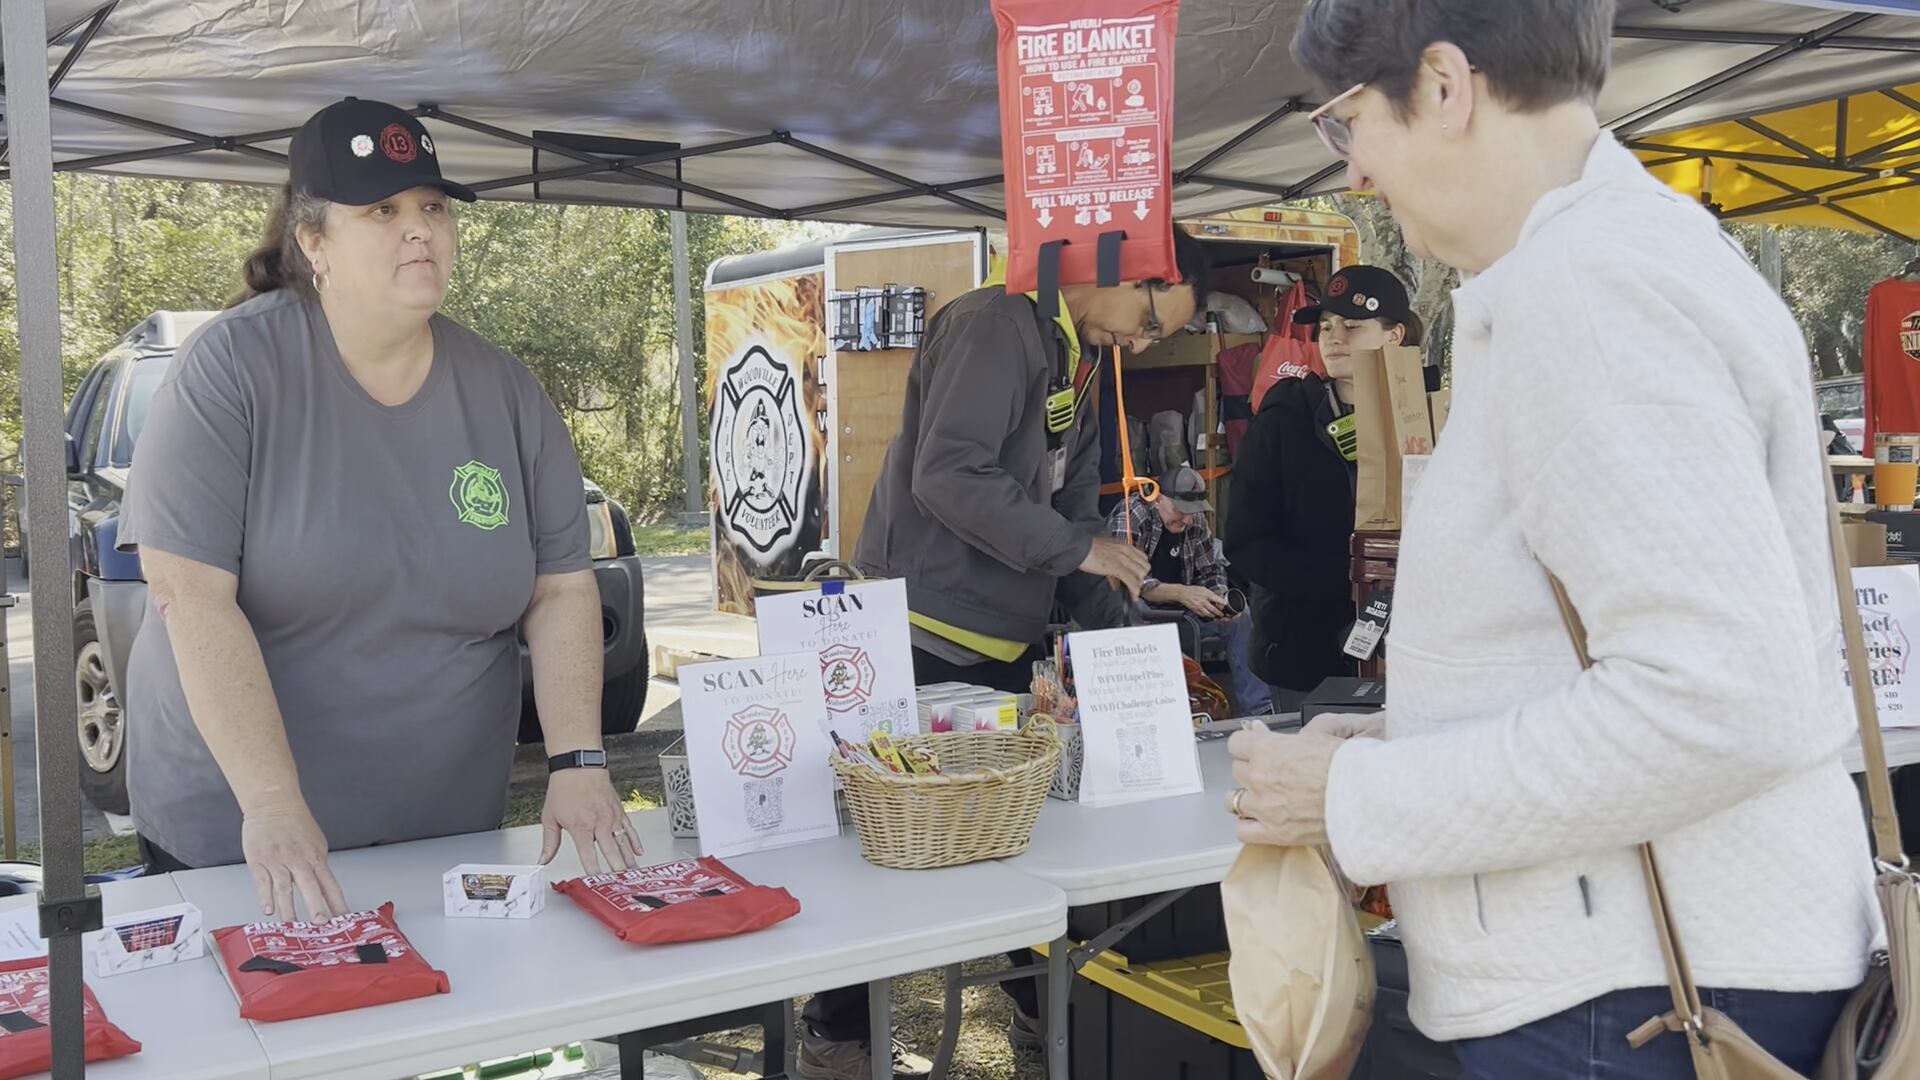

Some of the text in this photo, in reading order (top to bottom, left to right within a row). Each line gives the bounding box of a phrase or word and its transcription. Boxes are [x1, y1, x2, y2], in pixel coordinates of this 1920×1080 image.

[1017, 33, 1058, 59] FIRE
[1063, 24, 1155, 55] BLANKET
[1026, 64, 1046, 73] HOW
[1048, 62, 1059, 71] TO
[1061, 60, 1078, 70] USE
[1079, 59, 1086, 68] A
[1088, 57, 1107, 67] FIRE
[1109, 54, 1148, 66] BLANKET
[391, 136, 408, 151] 13
[1032, 196, 1057, 209] PULL
[1059, 193, 1091, 206] TAPES
[1093, 191, 1107, 204] TO
[1109, 187, 1155, 202] RELEASE
[802, 592, 863, 618] SCAN
[1855, 588, 1889, 606] ffle
[1092, 643, 1158, 659] Fire Blankets
[703, 669, 764, 692] SCAN
